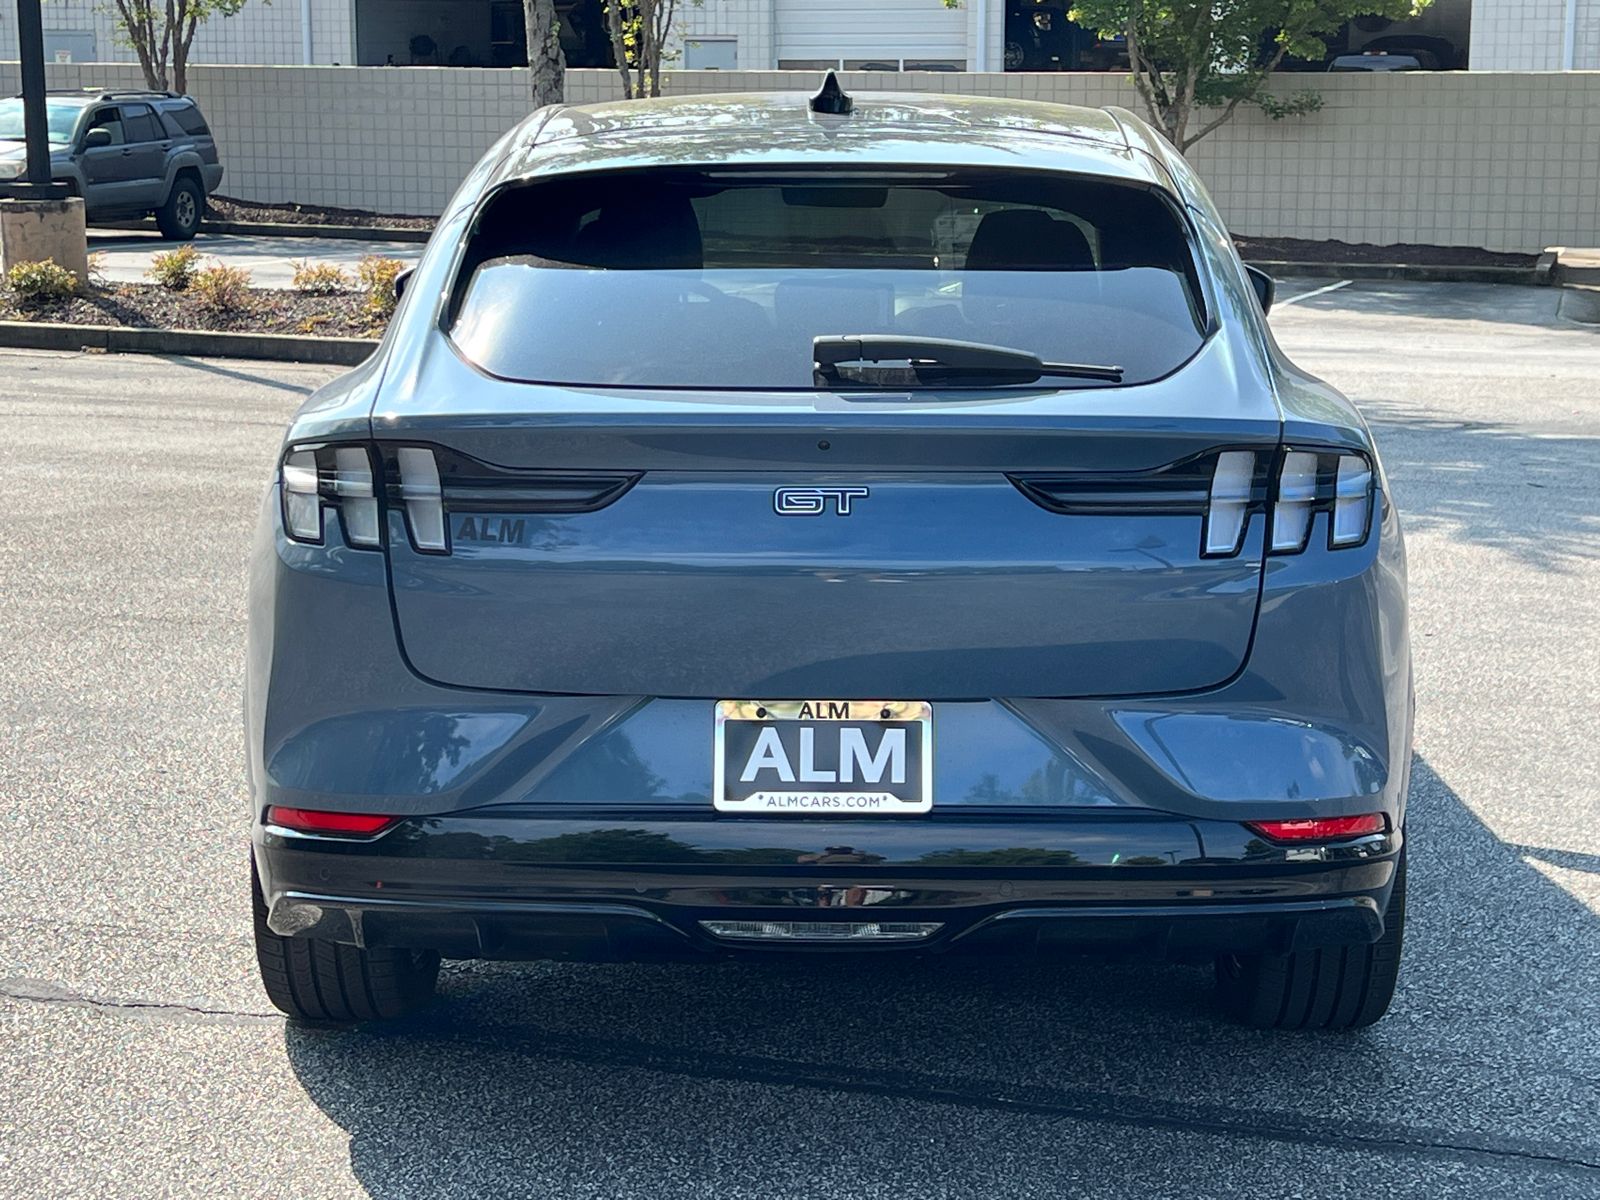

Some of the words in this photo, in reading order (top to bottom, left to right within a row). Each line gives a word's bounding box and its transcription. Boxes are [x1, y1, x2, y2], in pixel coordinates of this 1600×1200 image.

[773, 486, 869, 516] GT
[457, 517, 526, 543] ALM
[799, 702, 849, 719] ALM
[740, 726, 906, 783] ALM
[767, 796, 880, 808] ALMCARS.COM
